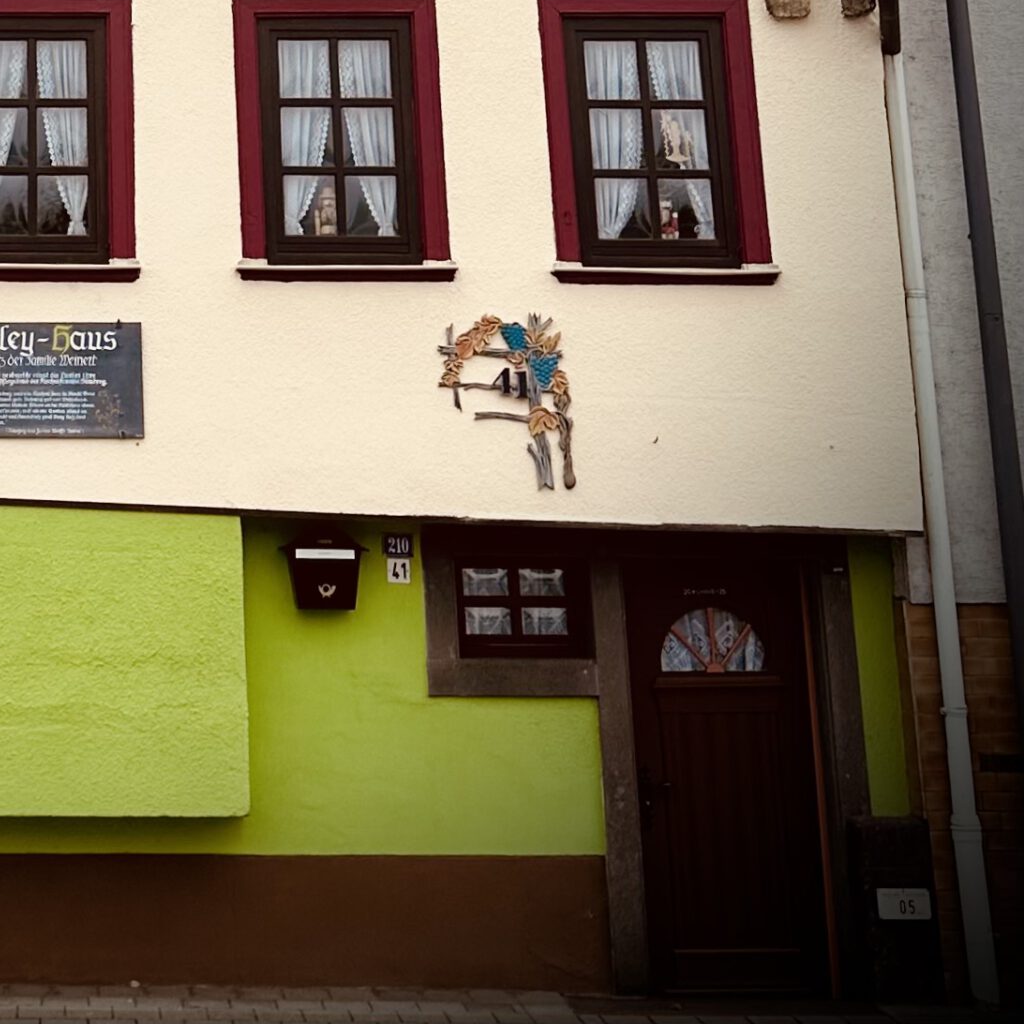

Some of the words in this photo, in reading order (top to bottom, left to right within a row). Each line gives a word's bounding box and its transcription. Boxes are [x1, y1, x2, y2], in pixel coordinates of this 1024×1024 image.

[7, 353, 23, 367] der
[492, 367, 528, 399] 41
[387, 536, 410, 554] 210
[391, 561, 408, 580] 41
